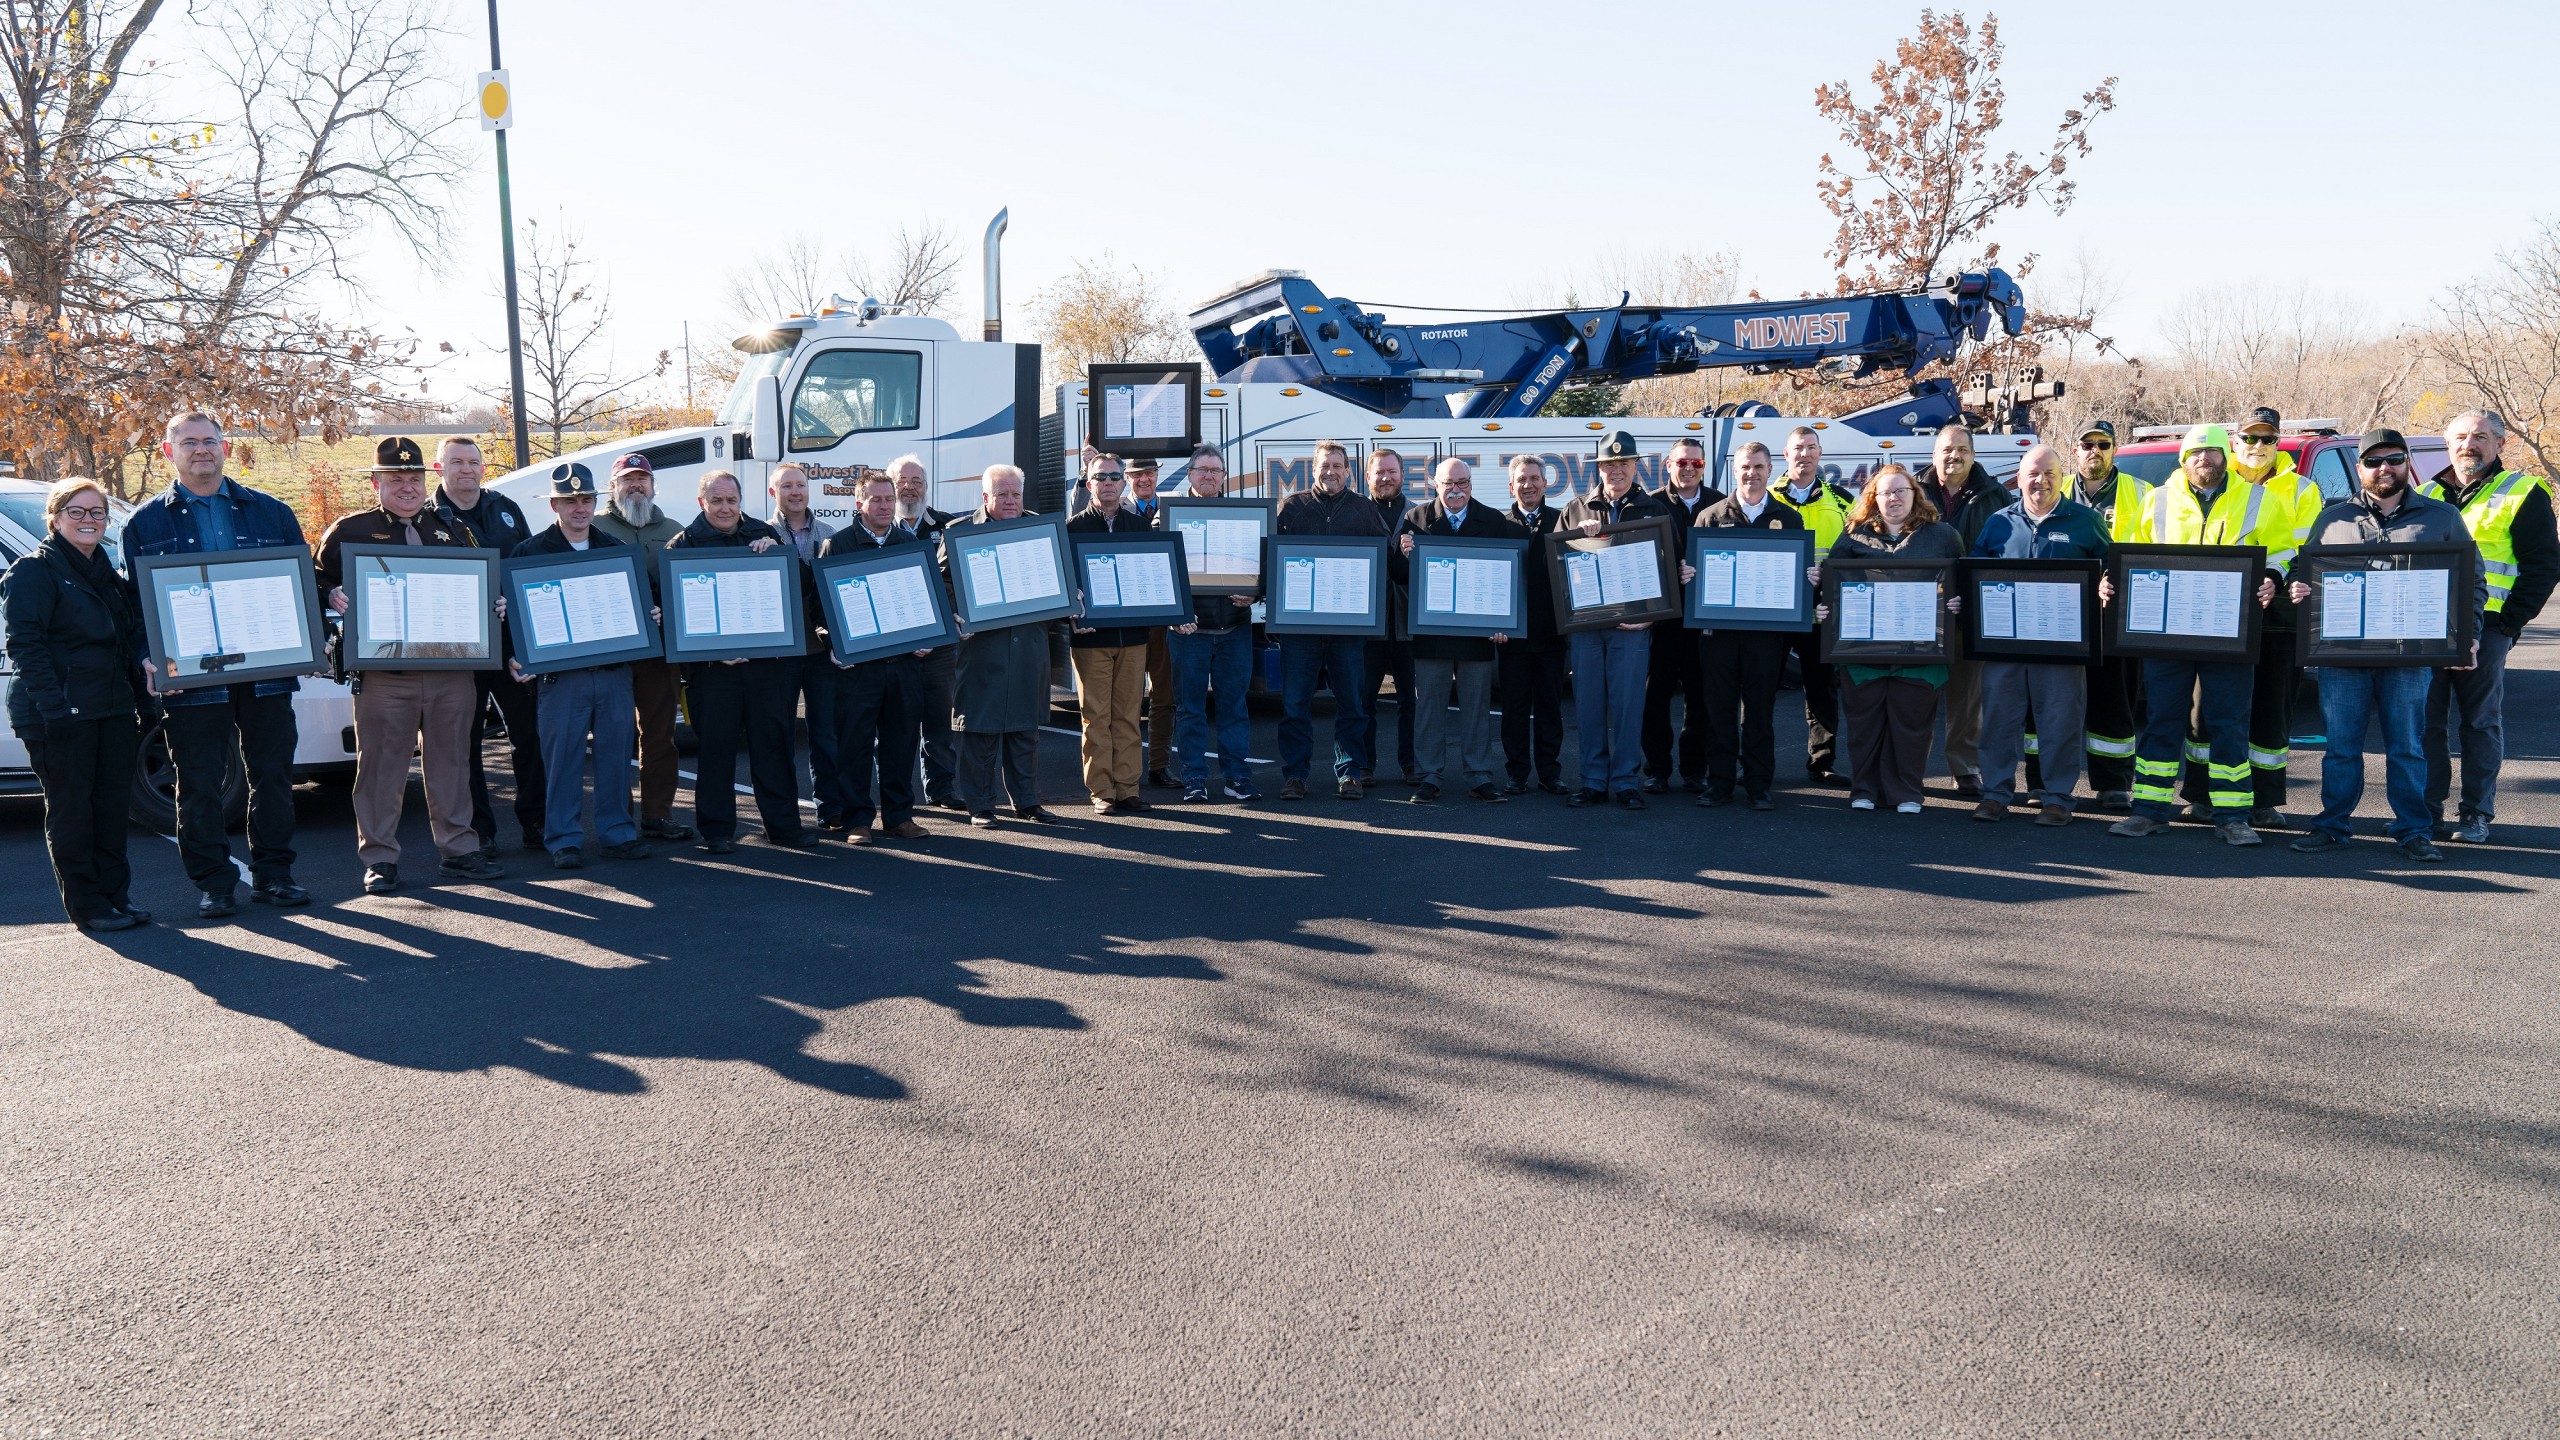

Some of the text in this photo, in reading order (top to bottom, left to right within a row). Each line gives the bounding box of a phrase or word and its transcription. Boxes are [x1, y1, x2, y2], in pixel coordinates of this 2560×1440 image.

[1421, 328, 1468, 341] ROTATOR
[1735, 312, 1850, 350] MIDWEST
[1520, 354, 1565, 405] 60 TON
